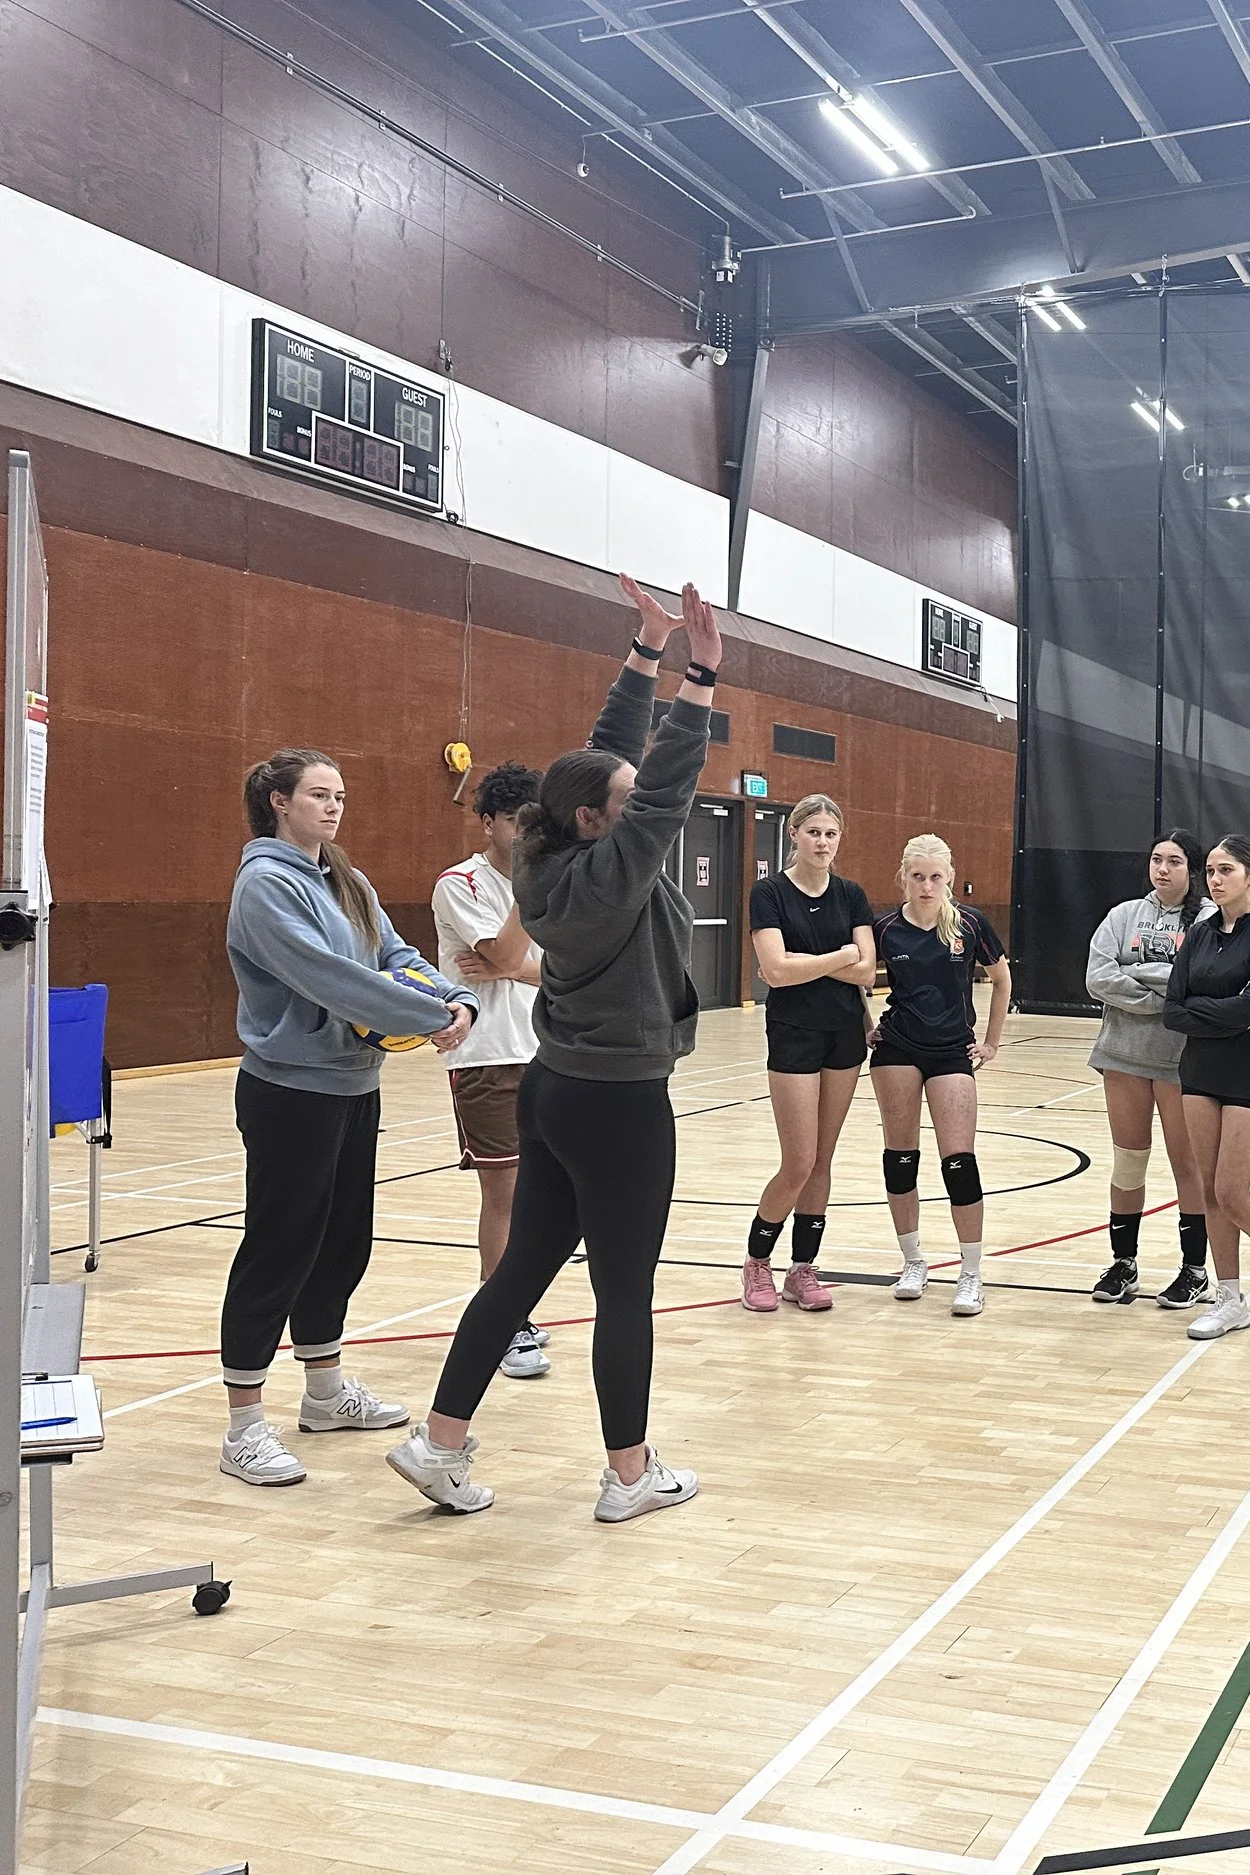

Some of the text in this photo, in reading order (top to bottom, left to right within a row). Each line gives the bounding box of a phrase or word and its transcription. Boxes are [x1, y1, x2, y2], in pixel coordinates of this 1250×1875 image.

[287, 339, 315, 363] HOME
[349, 364, 371, 381] PERIOD
[402, 387, 428, 408] GUEST
[268, 406, 283, 418] FOULS
[296, 426, 312, 438] BONUS
